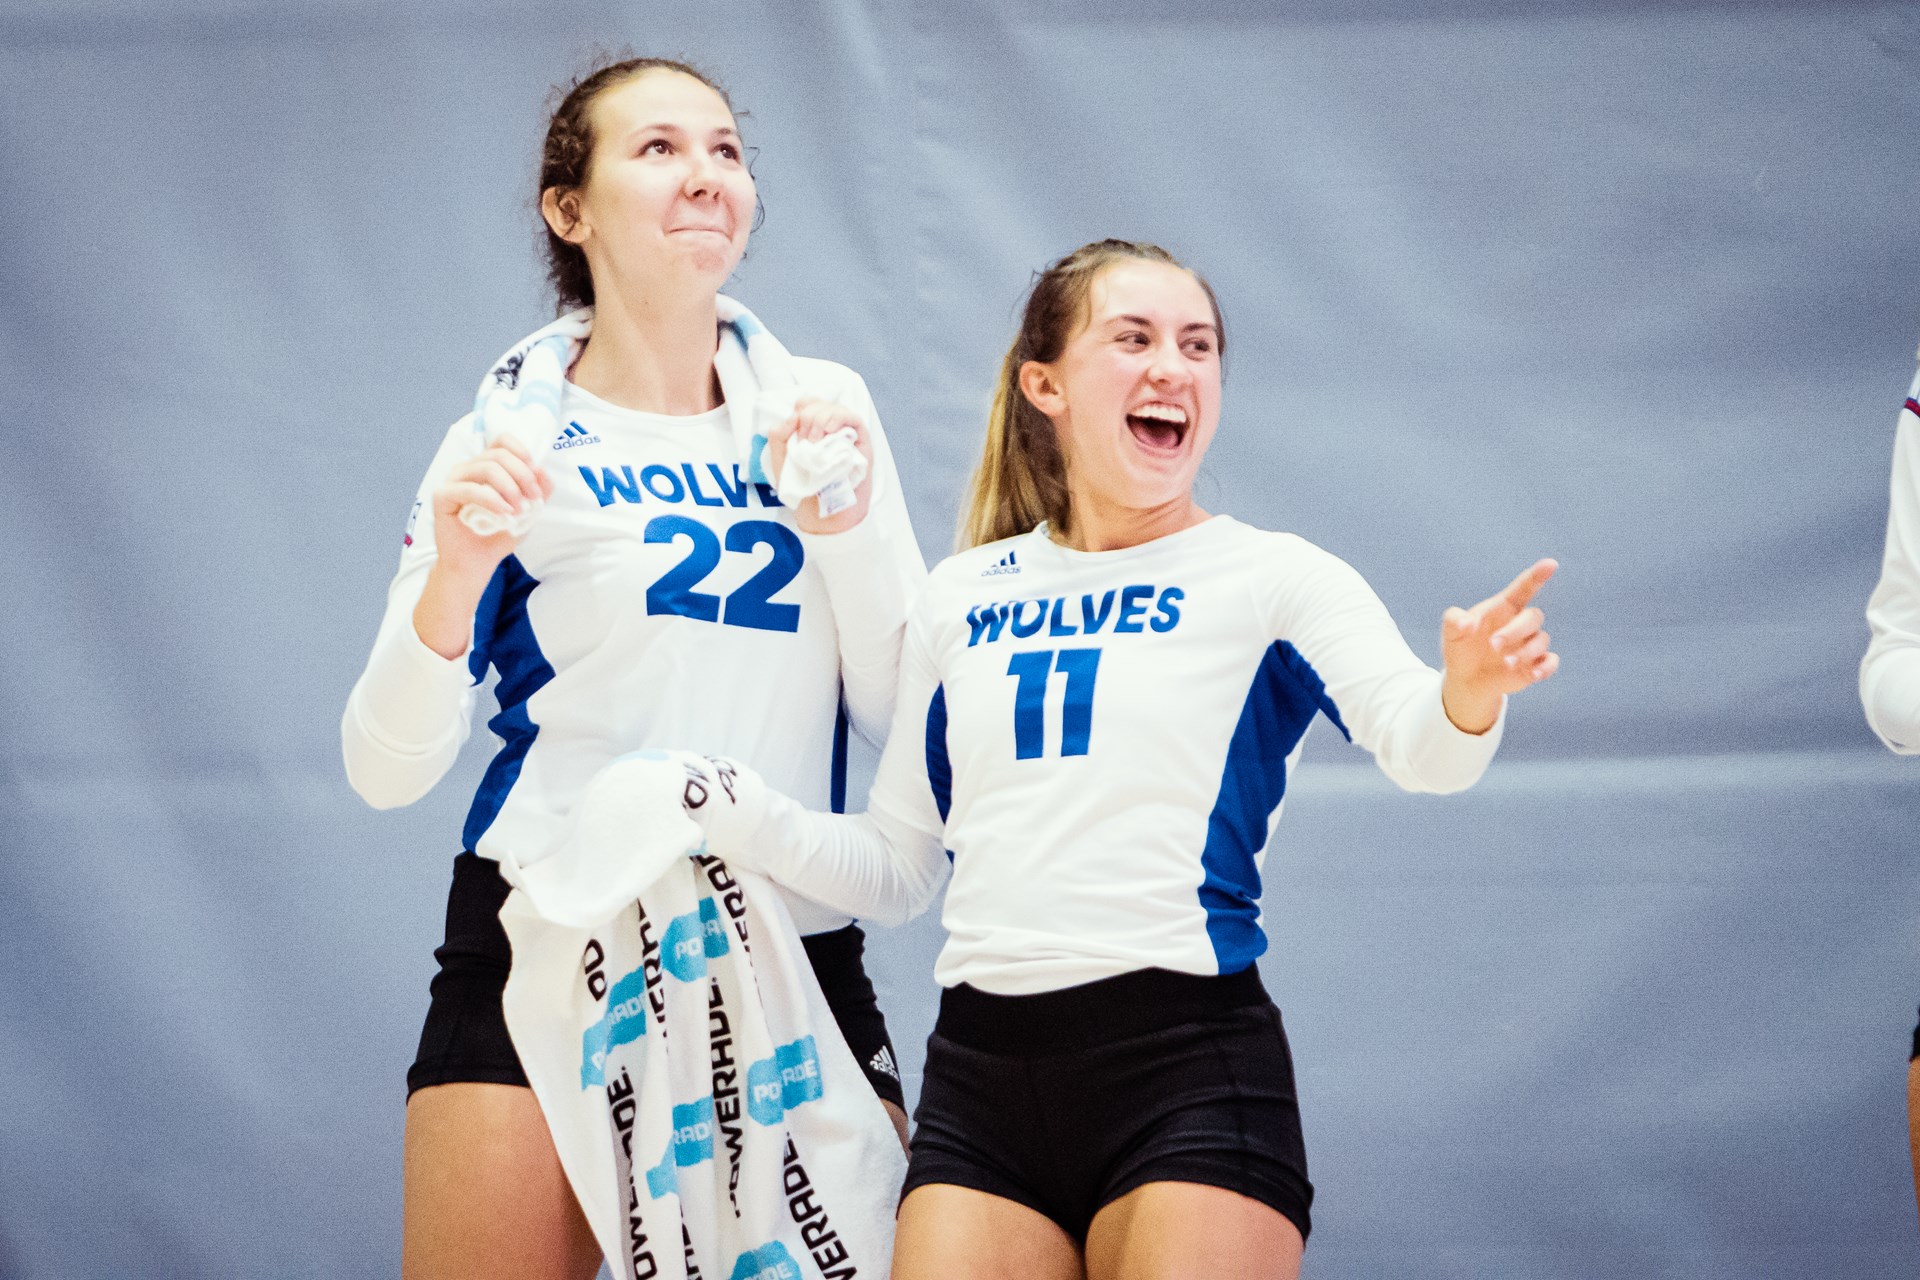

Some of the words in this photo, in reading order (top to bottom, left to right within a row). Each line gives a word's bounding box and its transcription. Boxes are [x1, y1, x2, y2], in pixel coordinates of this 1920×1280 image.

[553, 434, 601, 450] adidas
[578, 463, 786, 508] WOLVE
[643, 514, 804, 634] 22
[981, 565, 1021, 577] adidas
[966, 584, 1185, 648] WOLVES
[1006, 647, 1103, 761] 11
